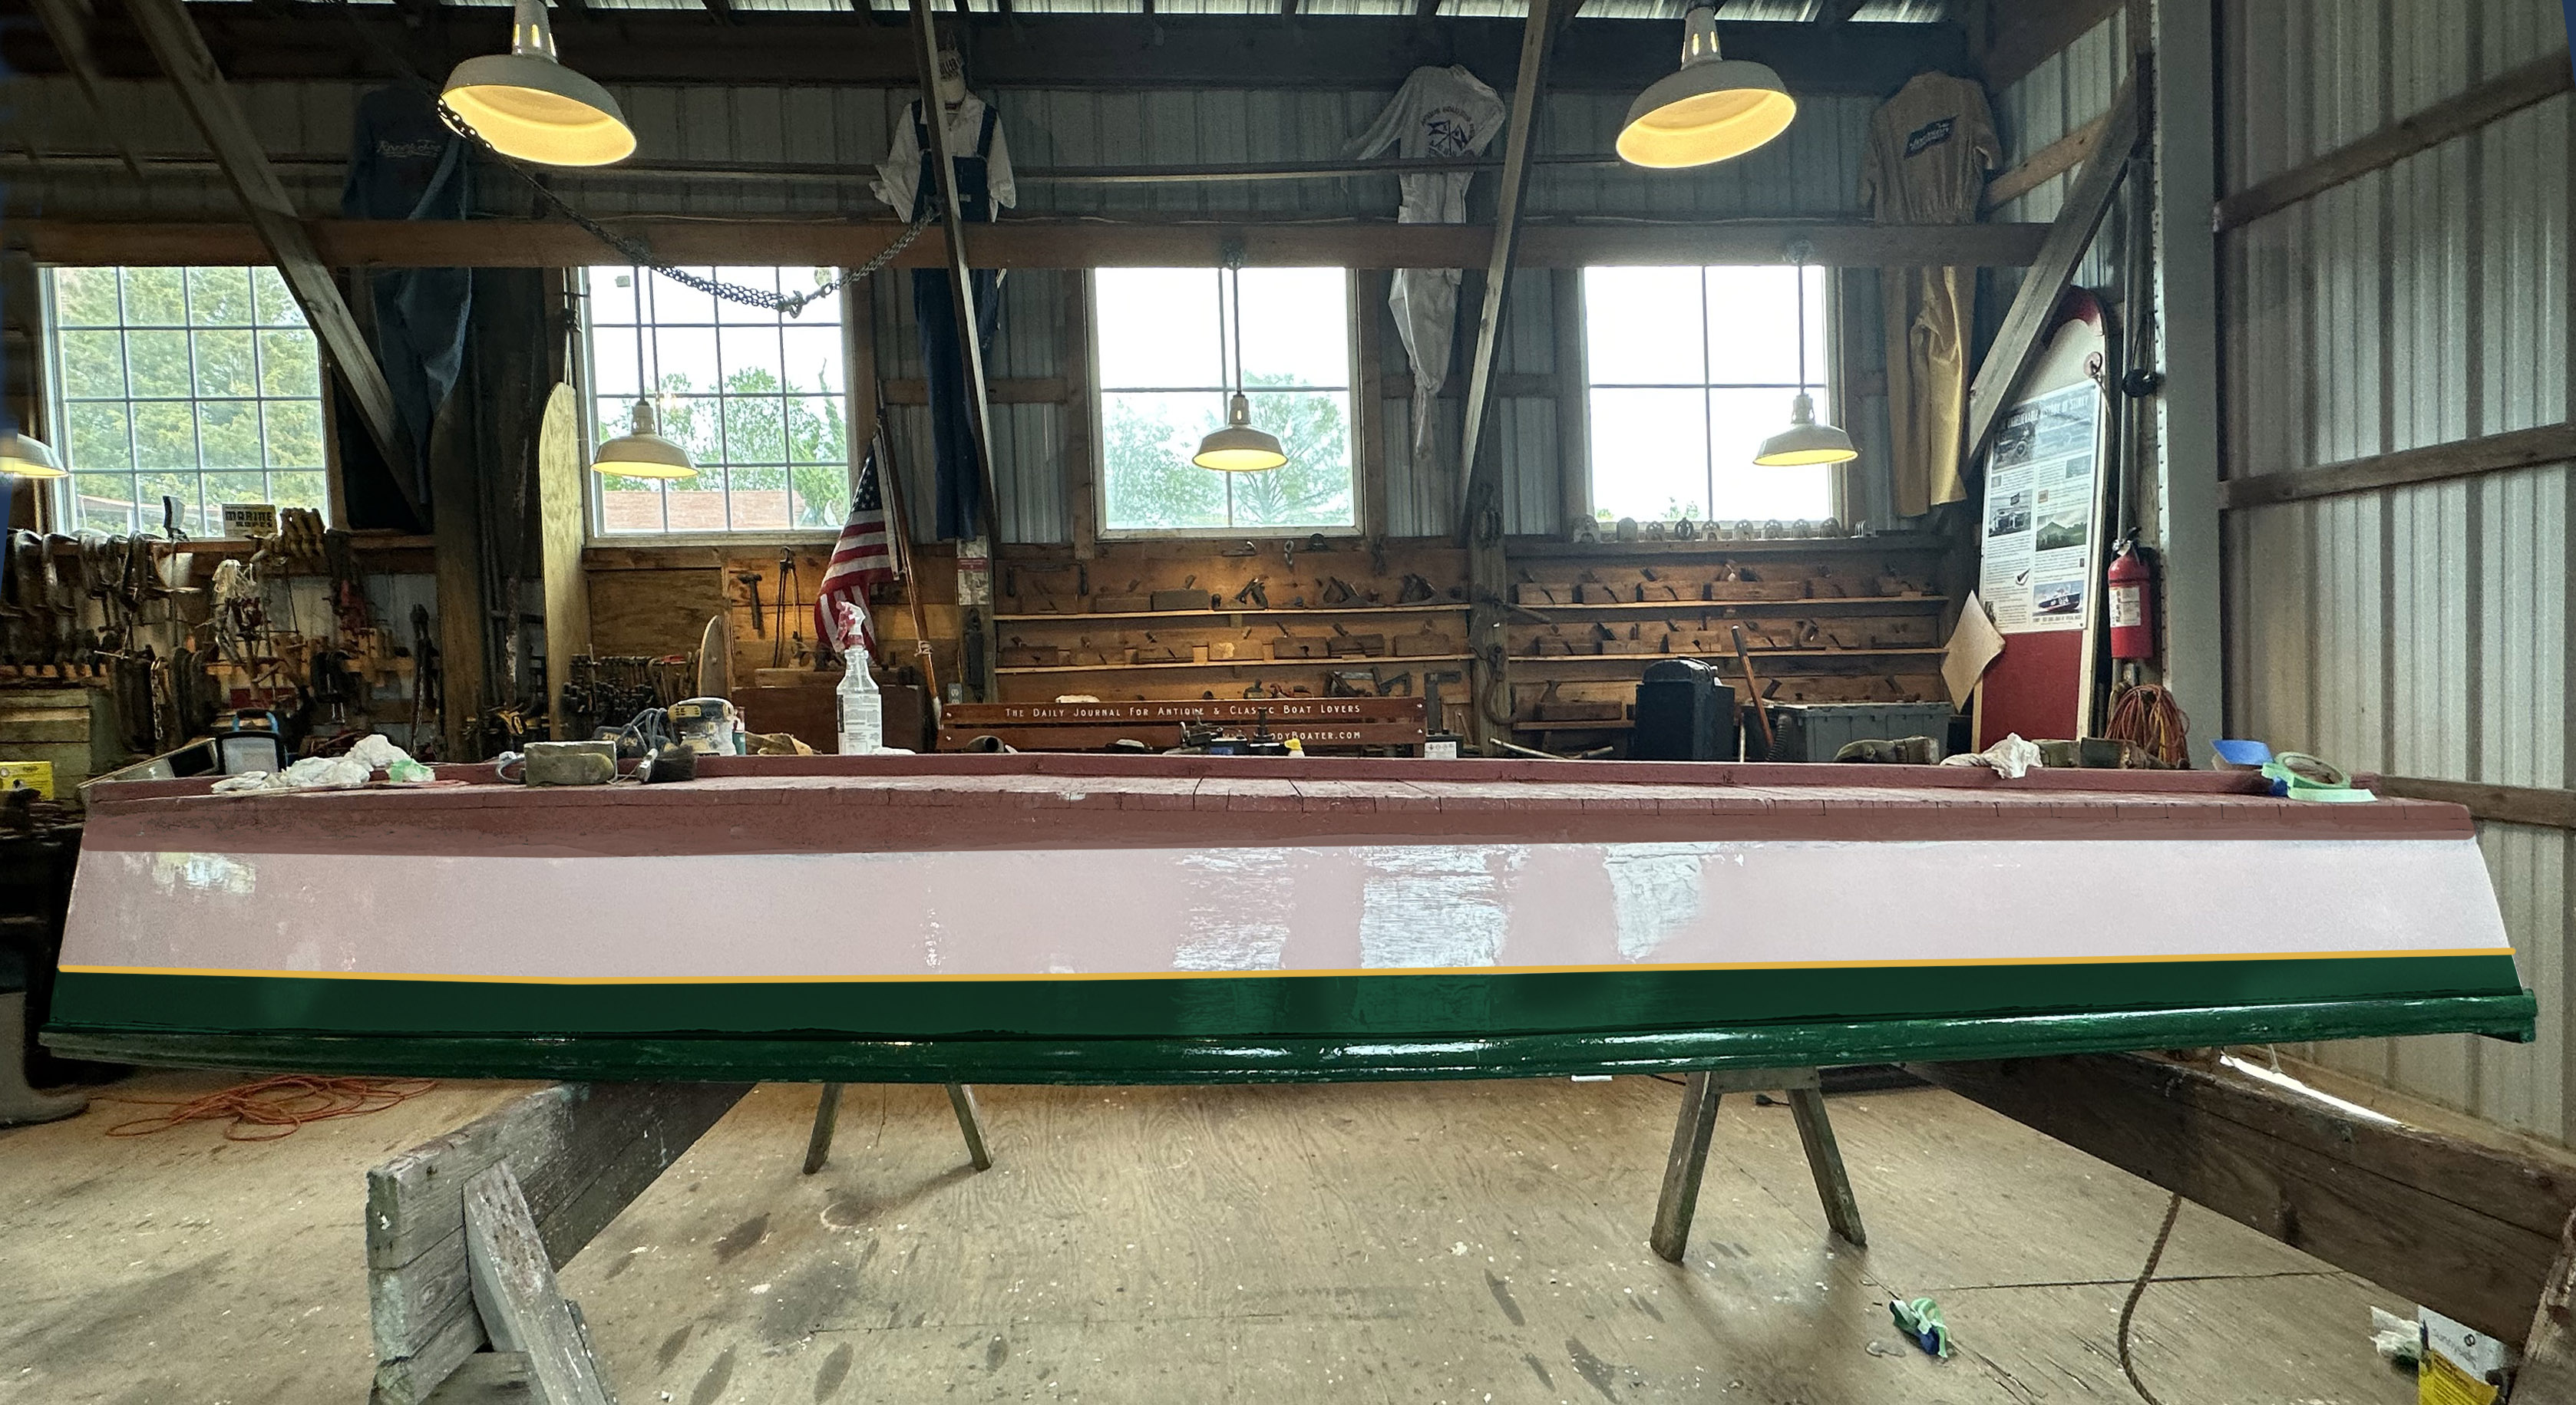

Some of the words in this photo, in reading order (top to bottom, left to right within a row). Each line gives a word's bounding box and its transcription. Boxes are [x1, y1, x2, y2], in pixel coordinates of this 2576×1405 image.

[225, 511, 272, 521] MARINE
[1006, 708, 1024, 717] THE
[1033, 708, 1064, 717] DAILY
[1074, 707, 1120, 717] JOURNAL
[1130, 707, 1148, 716] FOR
[1230, 706, 1274, 714] CLASC
[1283, 705, 1312, 714] BOAT
[1320, 704, 1360, 713] LOVERS
